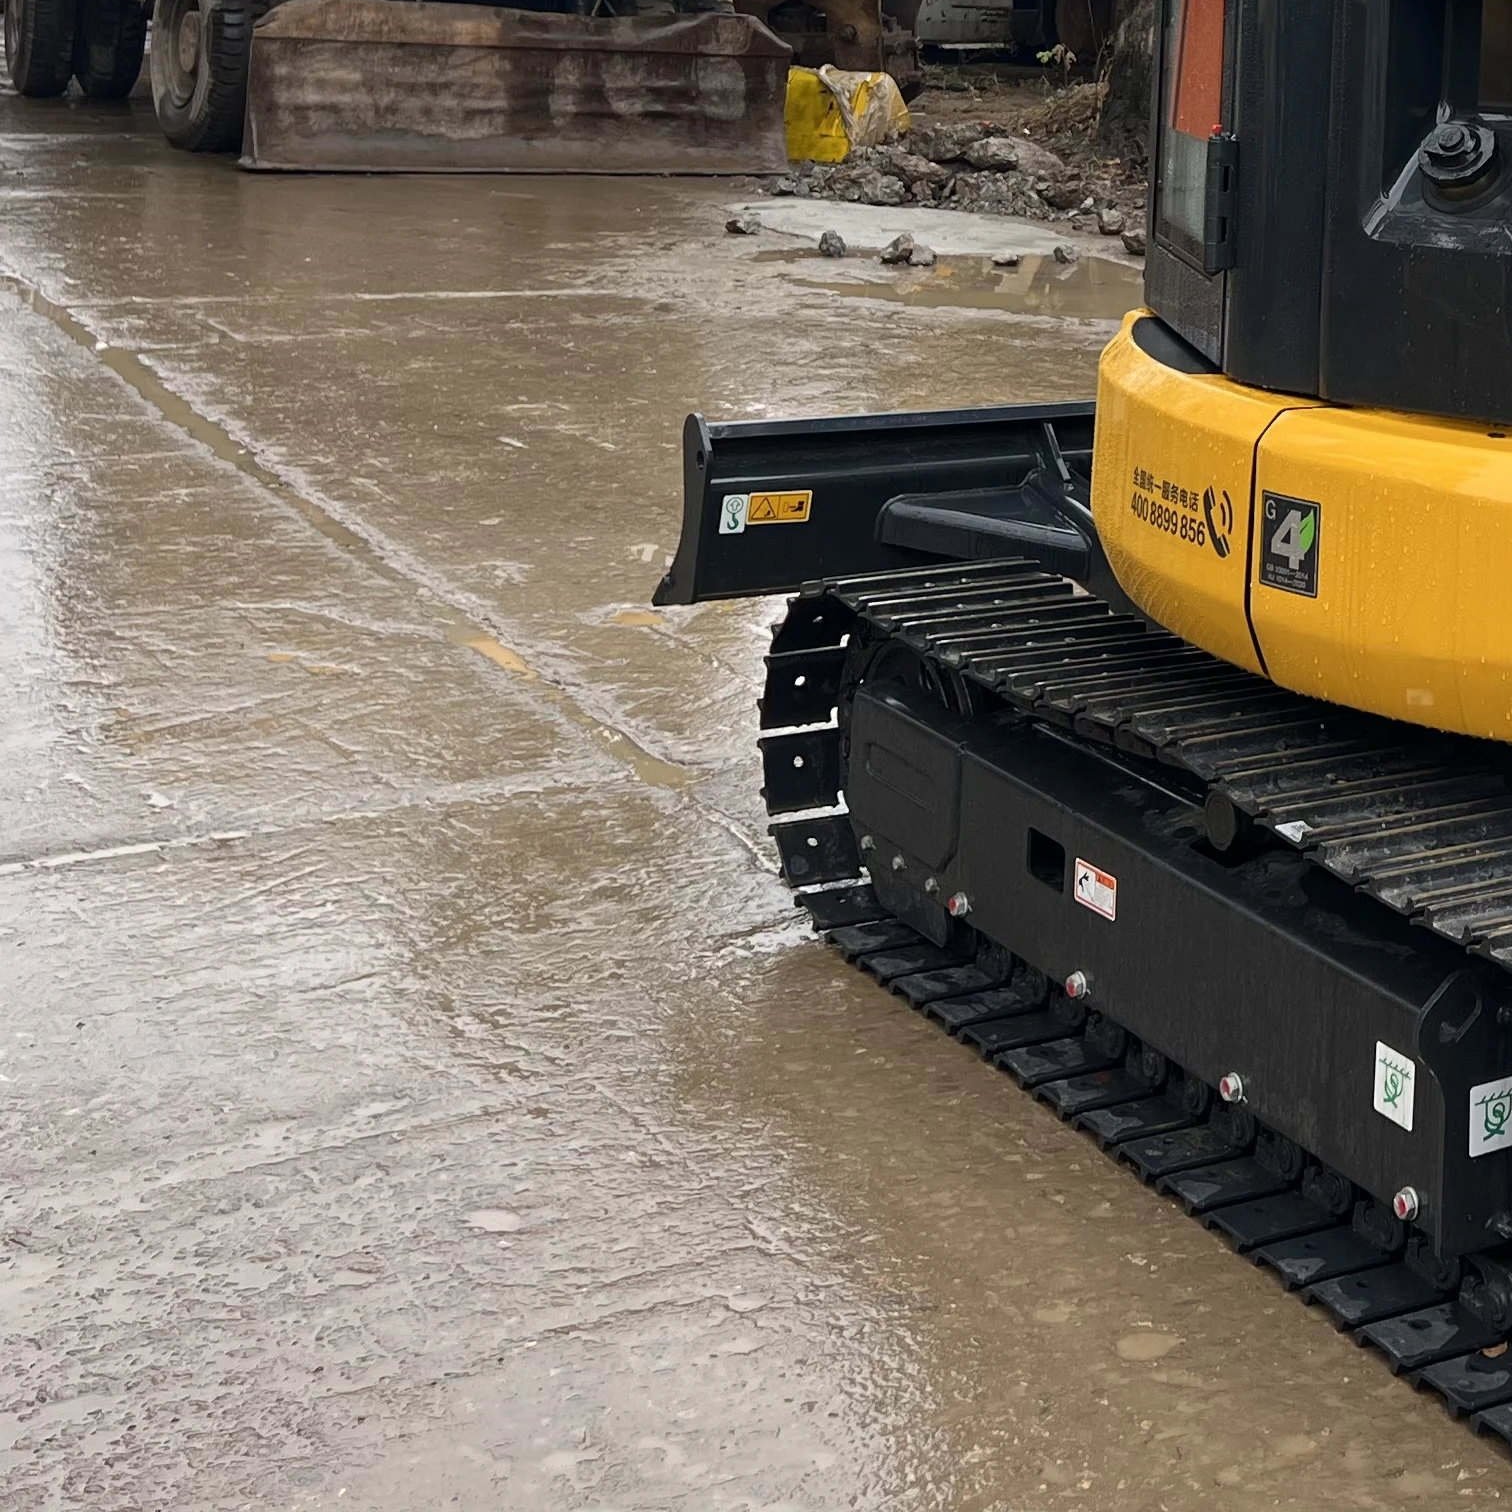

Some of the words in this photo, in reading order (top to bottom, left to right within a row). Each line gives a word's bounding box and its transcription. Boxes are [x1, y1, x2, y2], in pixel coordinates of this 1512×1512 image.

[1131, 491, 1149, 522] 400
[1150, 500, 1178, 536] 8899
[1180, 514, 1206, 547] 856
[1265, 499, 1277, 520] G
[1271, 509, 1305, 570] 4
